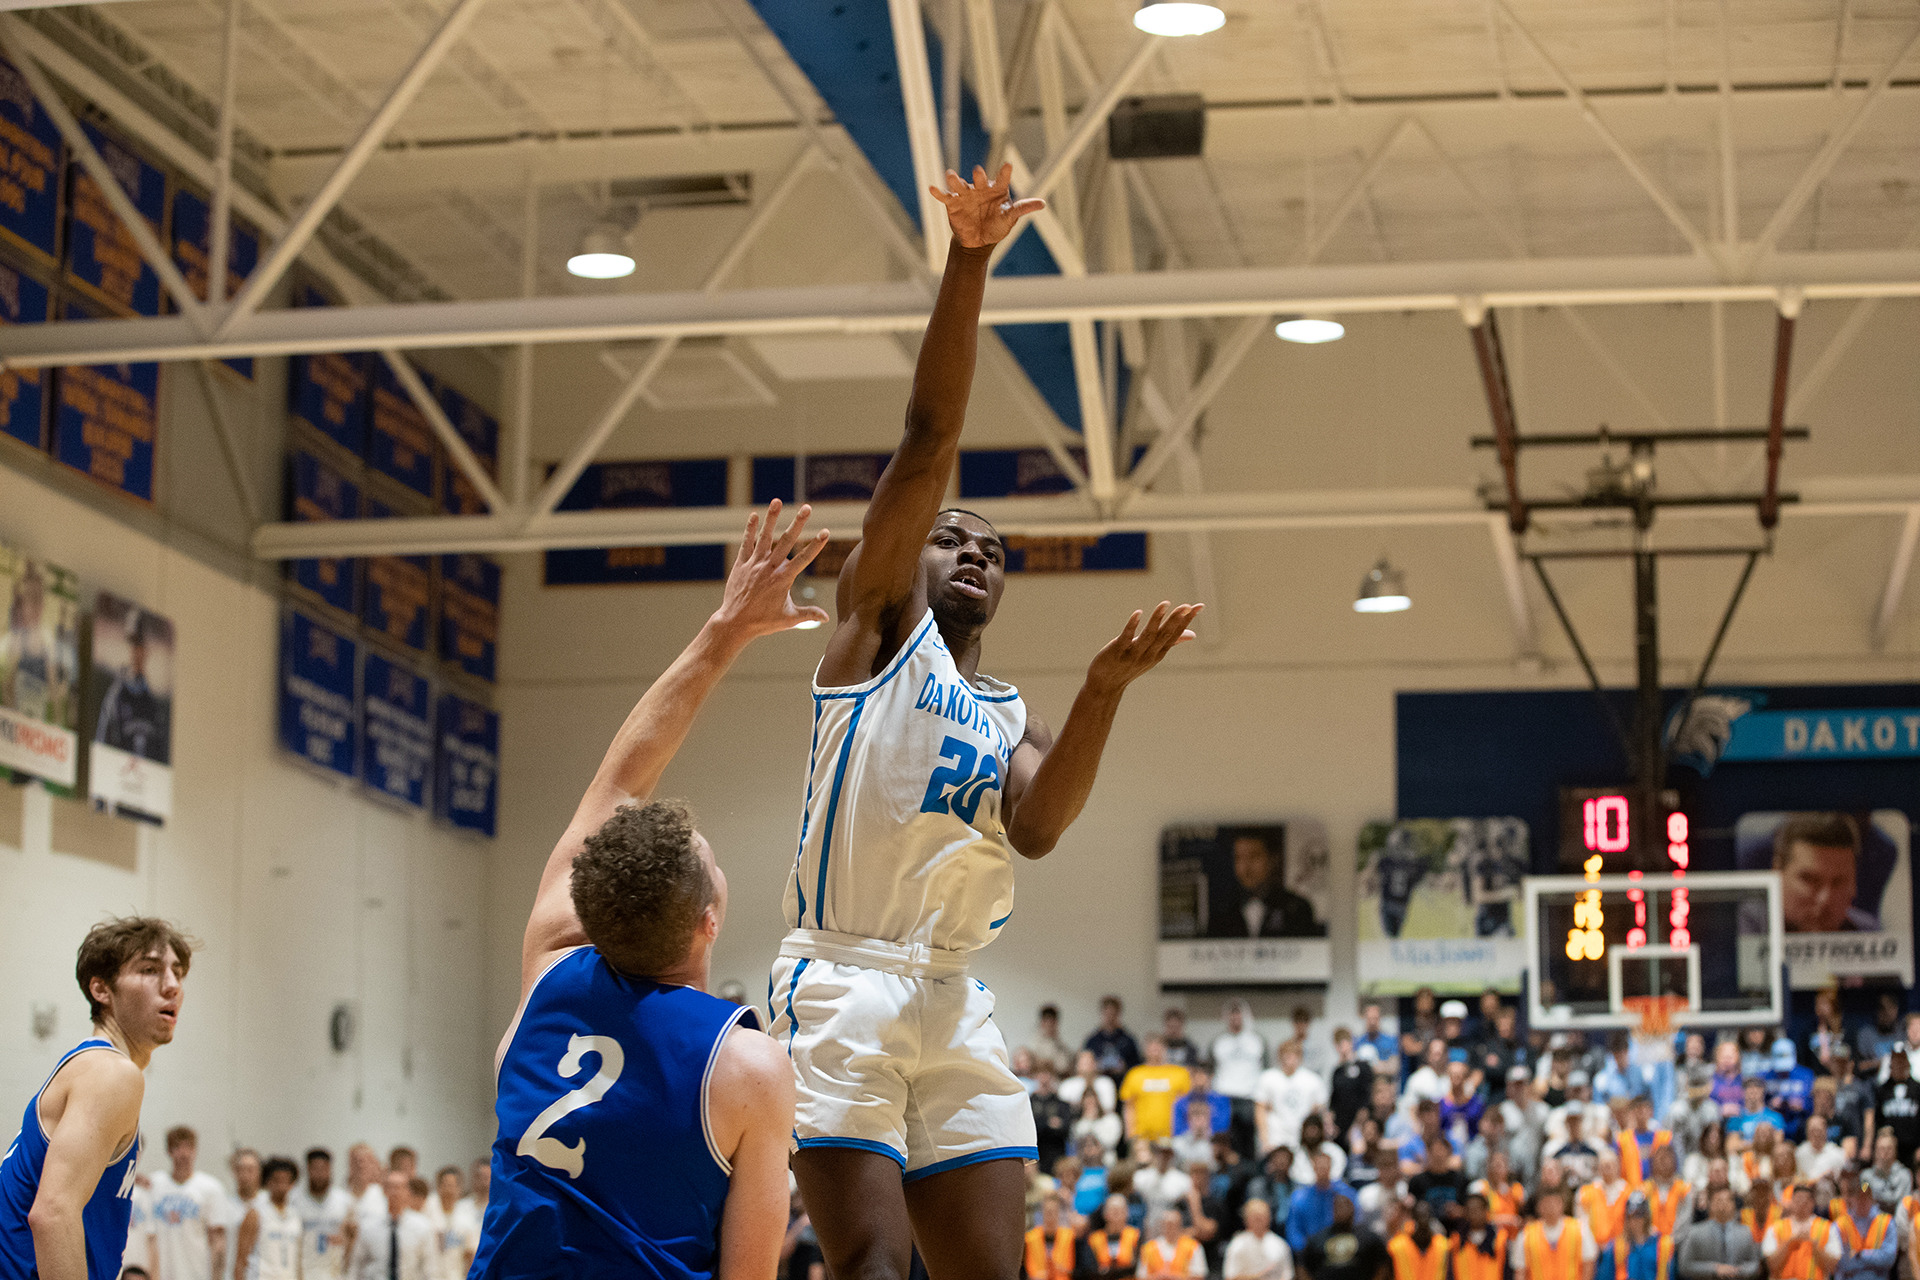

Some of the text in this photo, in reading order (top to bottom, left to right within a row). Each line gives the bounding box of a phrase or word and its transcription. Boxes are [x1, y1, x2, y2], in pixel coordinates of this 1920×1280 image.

[914, 672, 990, 739] DAKOTA
[919, 735, 1000, 825] 20
[1583, 795, 1630, 852] 10
[516, 1032, 625, 1180] 2
